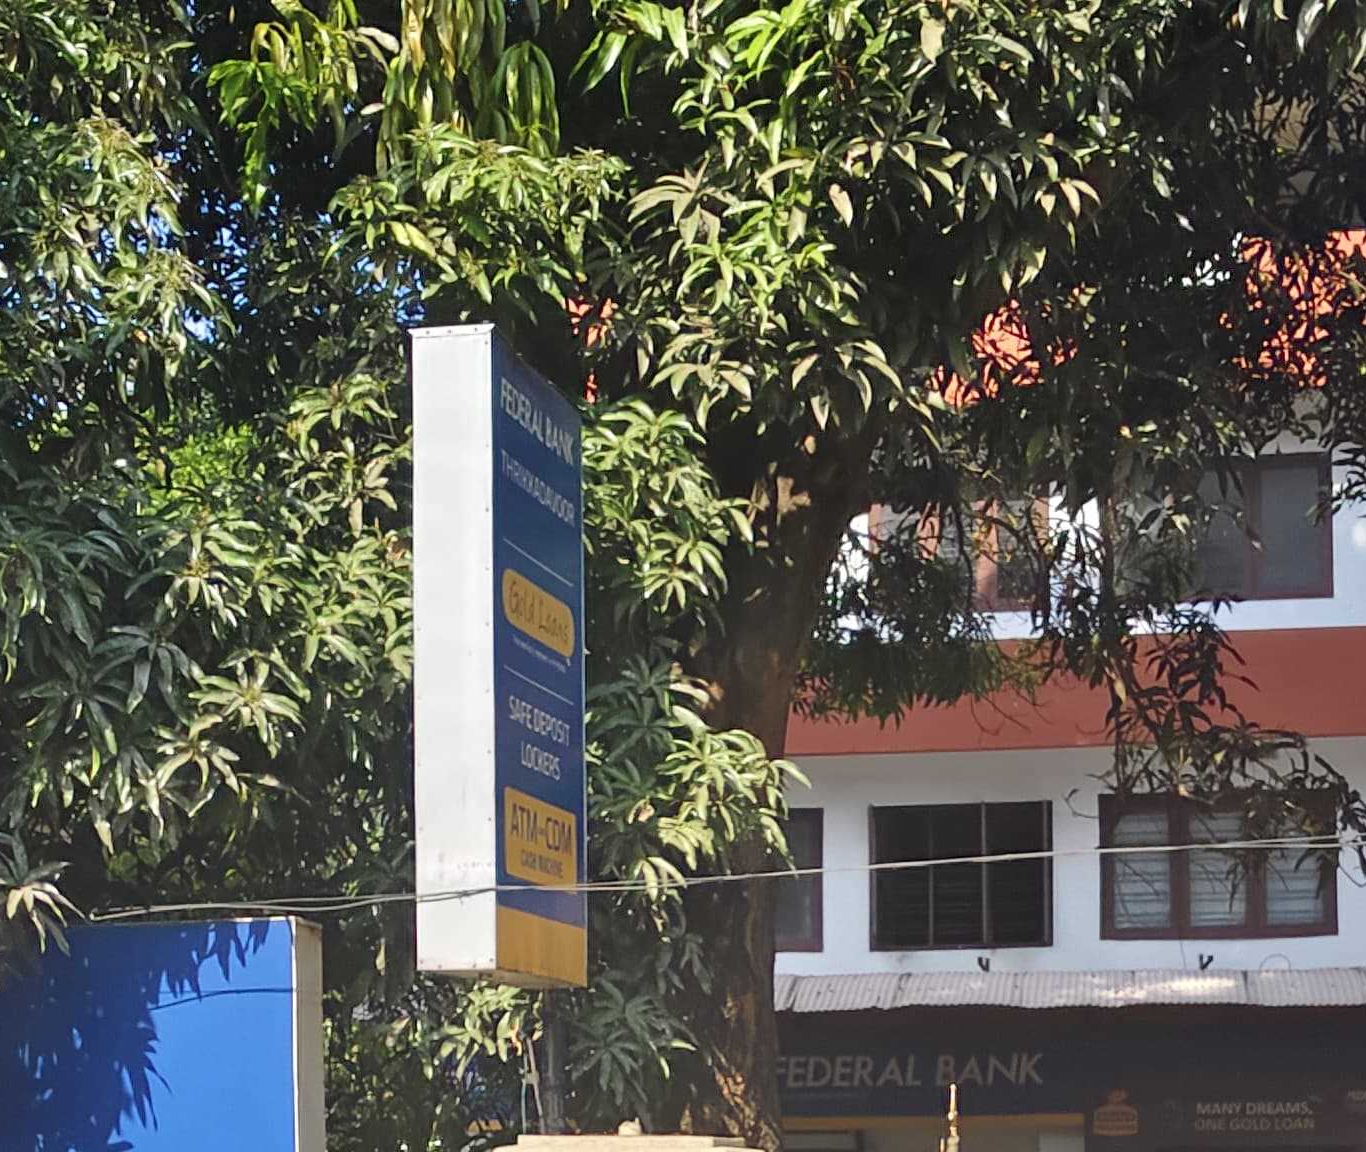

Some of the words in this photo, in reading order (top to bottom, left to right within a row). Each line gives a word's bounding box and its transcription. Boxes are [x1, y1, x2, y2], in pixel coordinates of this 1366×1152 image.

[500, 376, 544, 445] FEDERAL
[544, 414, 574, 466] BANK
[508, 695, 533, 731] SAFE
[533, 707, 571, 747] DEPOSIT
[521, 739, 561, 781] LOCKERS
[510, 803, 572, 855] ATM-CDM
[936, 1052, 1044, 1086] BANK
[1195, 1102, 1241, 1115] MANY
[1195, 1117, 1226, 1131] ONE
[1229, 1117, 1271, 1131] GOLD
[1274, 1117, 1316, 1131] LOAN
